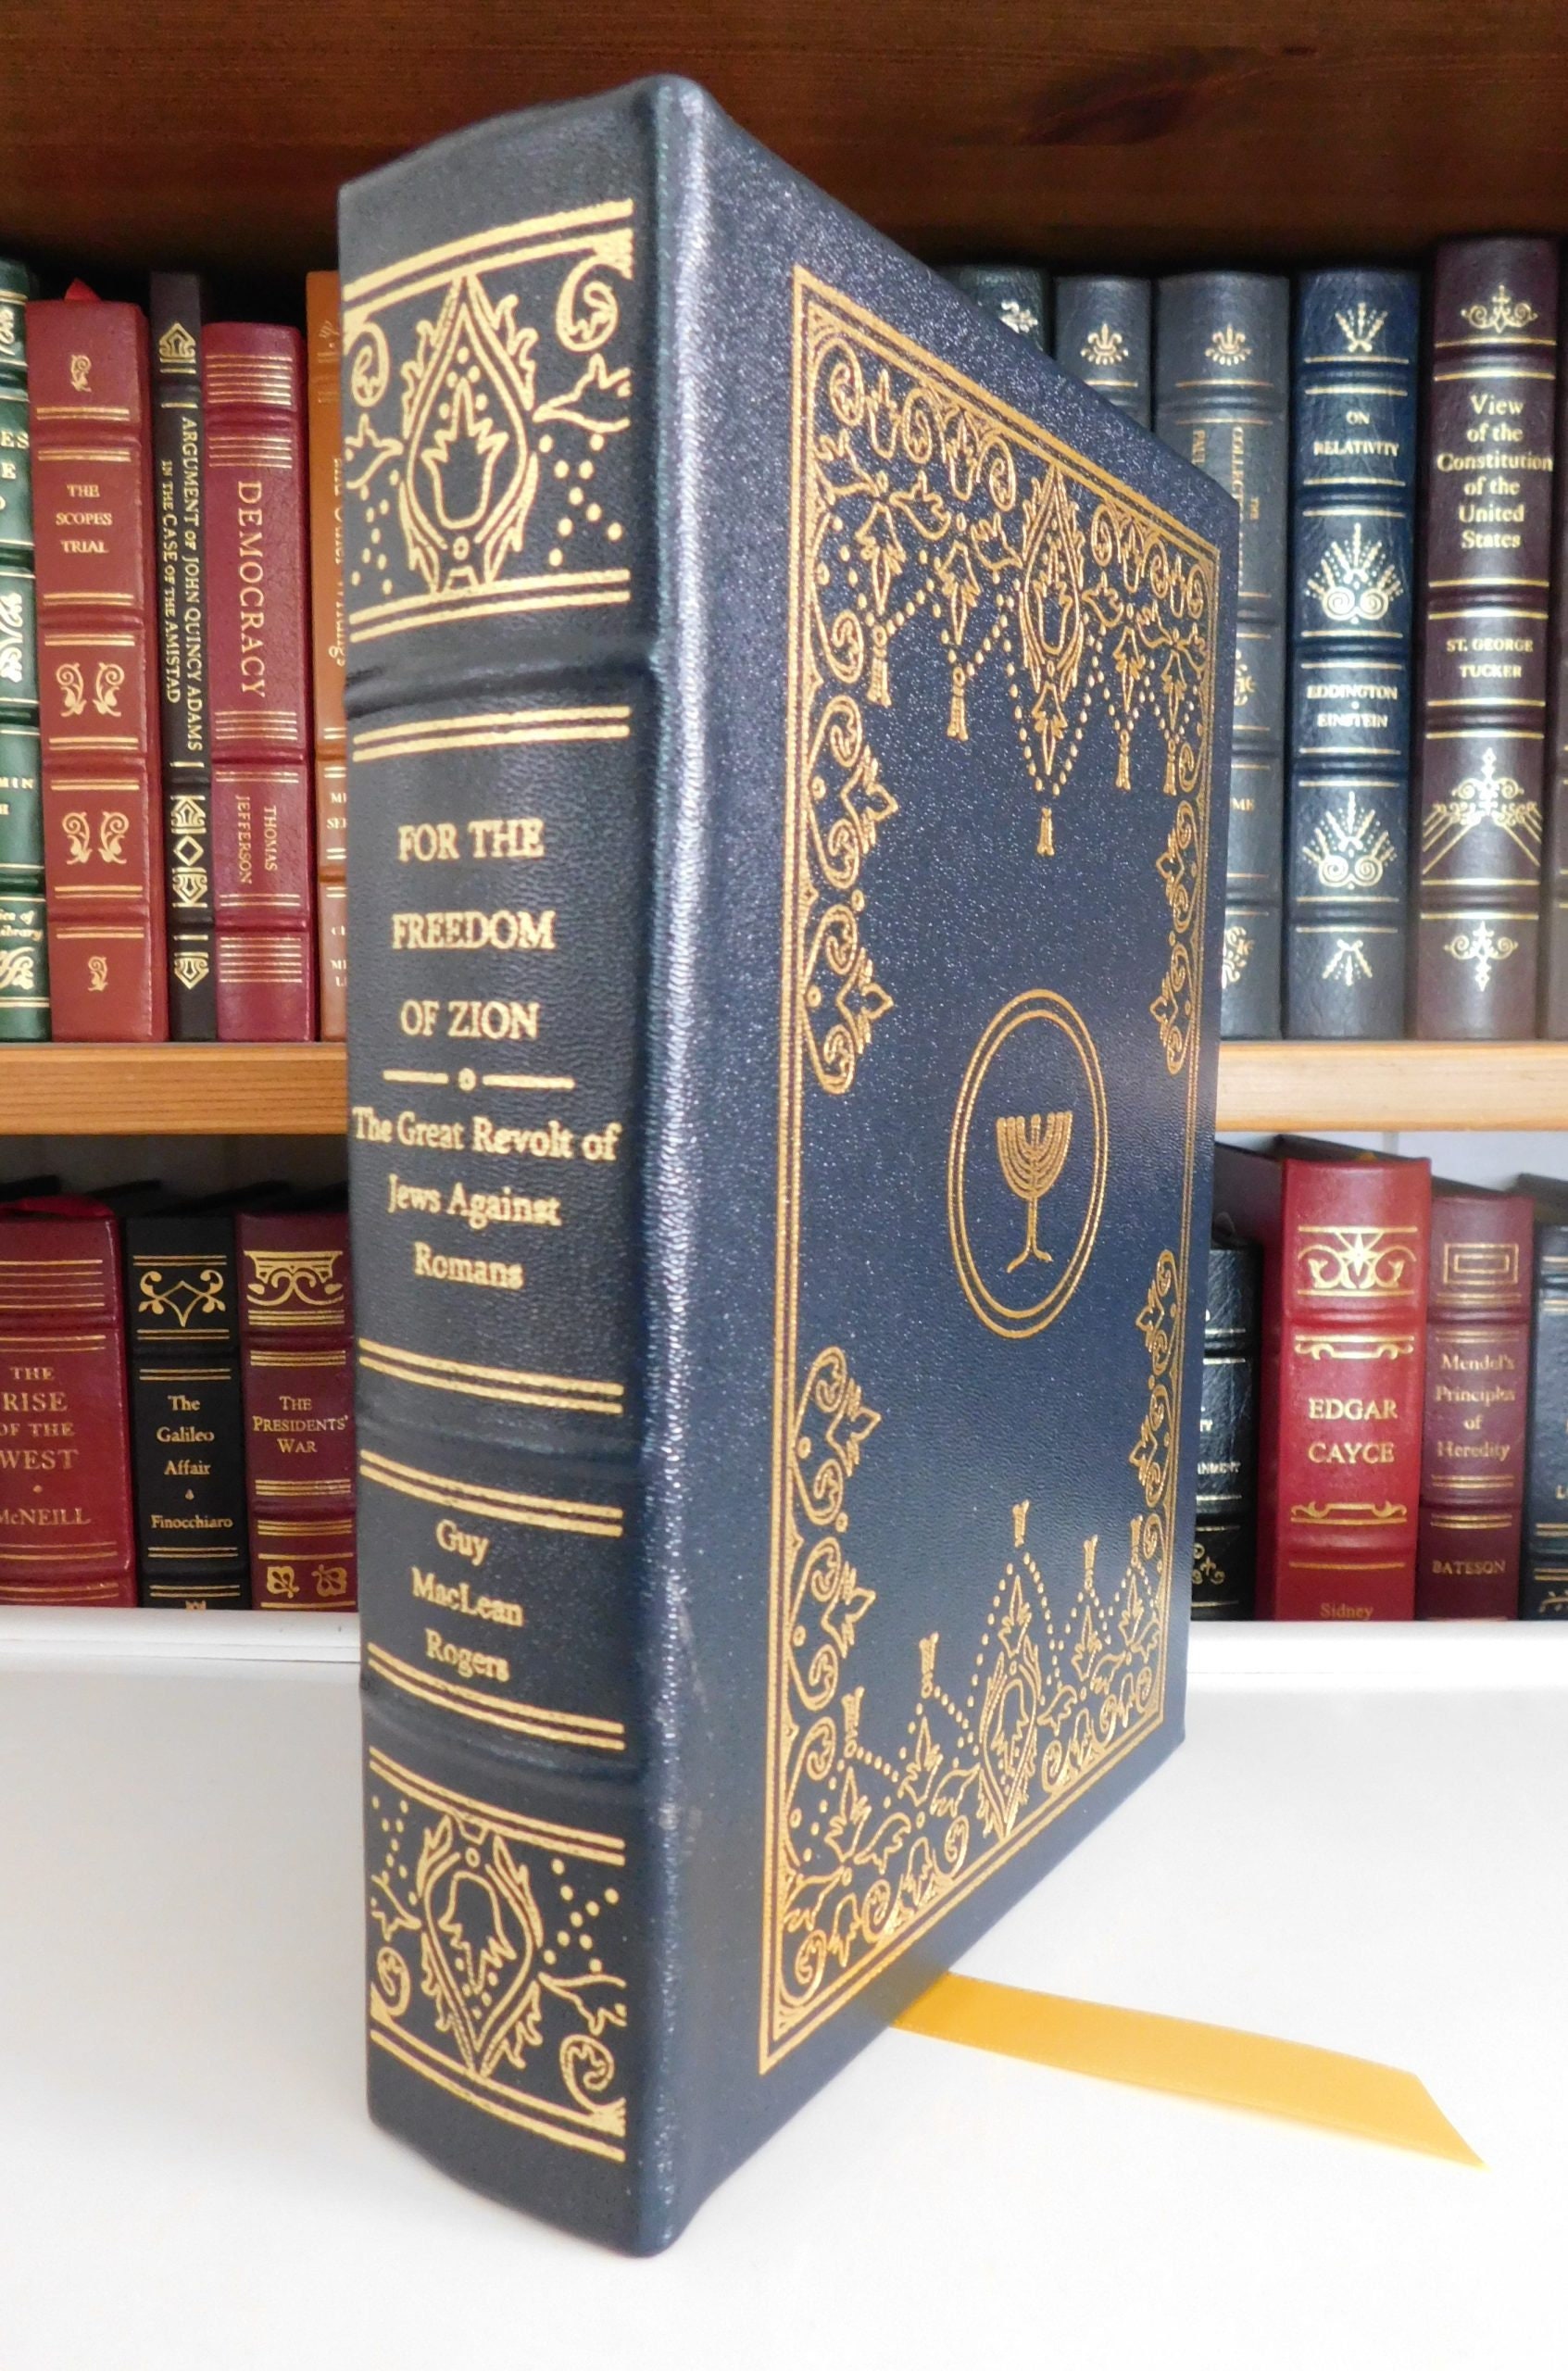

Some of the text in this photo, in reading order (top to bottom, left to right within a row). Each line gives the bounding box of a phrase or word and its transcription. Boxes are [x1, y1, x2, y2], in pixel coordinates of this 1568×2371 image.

[1471, 394, 1524, 415] View
[1346, 410, 1370, 425] ON
[1467, 426, 1524, 443] of the
[1313, 439, 1399, 457] RELATIVITY
[1436, 453, 1554, 473] Constitution
[67, 483, 100, 498] THE
[1464, 479, 1521, 496] of the
[56, 512, 113, 526] SCOPES
[1458, 504, 1524, 522] United
[61, 540, 109, 554] TRIAL
[1461, 531, 1522, 548] States
[161, 459, 182, 704] IN THE CASE OF THE AMISTAD
[182, 417, 204, 752] ARGUMENT OF JOHN QUINCY ADAMS
[238, 480, 267, 698] DEMOCRACY
[1446, 637, 1534, 653] ST. GEORGE
[1460, 664, 1523, 679] TUCKER
[1306, 684, 1399, 701] EDDINGTON
[1317, 712, 1389, 729] EINSTEIN
[235, 795, 254, 884] JEFFERSON
[264, 805, 279, 871] THOMAS
[398, 818, 546, 861] FOR THE
[391, 910, 558, 950] FREEDOM
[400, 1000, 540, 1040] OF ZION
[352, 1106, 622, 1162] The Great Revolt of
[387, 1174, 562, 1229] Jews Against
[413, 1242, 524, 1289] Romans
[1441, 1354, 1515, 1371] Mendel's
[10, 1367, 55, 1380] THE
[3, 1391, 68, 1411] RISE
[169, 1395, 200, 1411] The
[280, 1396, 312, 1411] THE
[1435, 1384, 1516, 1408] Principles
[1308, 1398, 1399, 1420] EDGAR
[28, 1422, 76, 1436] THE
[1463, 1415, 1484, 1431] of
[157, 1426, 215, 1444] Galileo
[277, 1438, 318, 1453] WAR
[1308, 1441, 1395, 1465] CAYCE
[1436, 1441, 1511, 1461] Heredity
[0, 1449, 80, 1470] WEST
[164, 1460, 211, 1476] Affair
[0, 1507, 92, 1525] McNEILL
[150, 1514, 233, 1531] Finocchiaro
[435, 1519, 491, 1566] Guy
[1432, 1560, 1506, 1575] BATESON
[410, 1566, 525, 1627] MacLean
[1320, 1602, 1374, 1619] Sidney
[425, 1627, 510, 1682] Rogers
